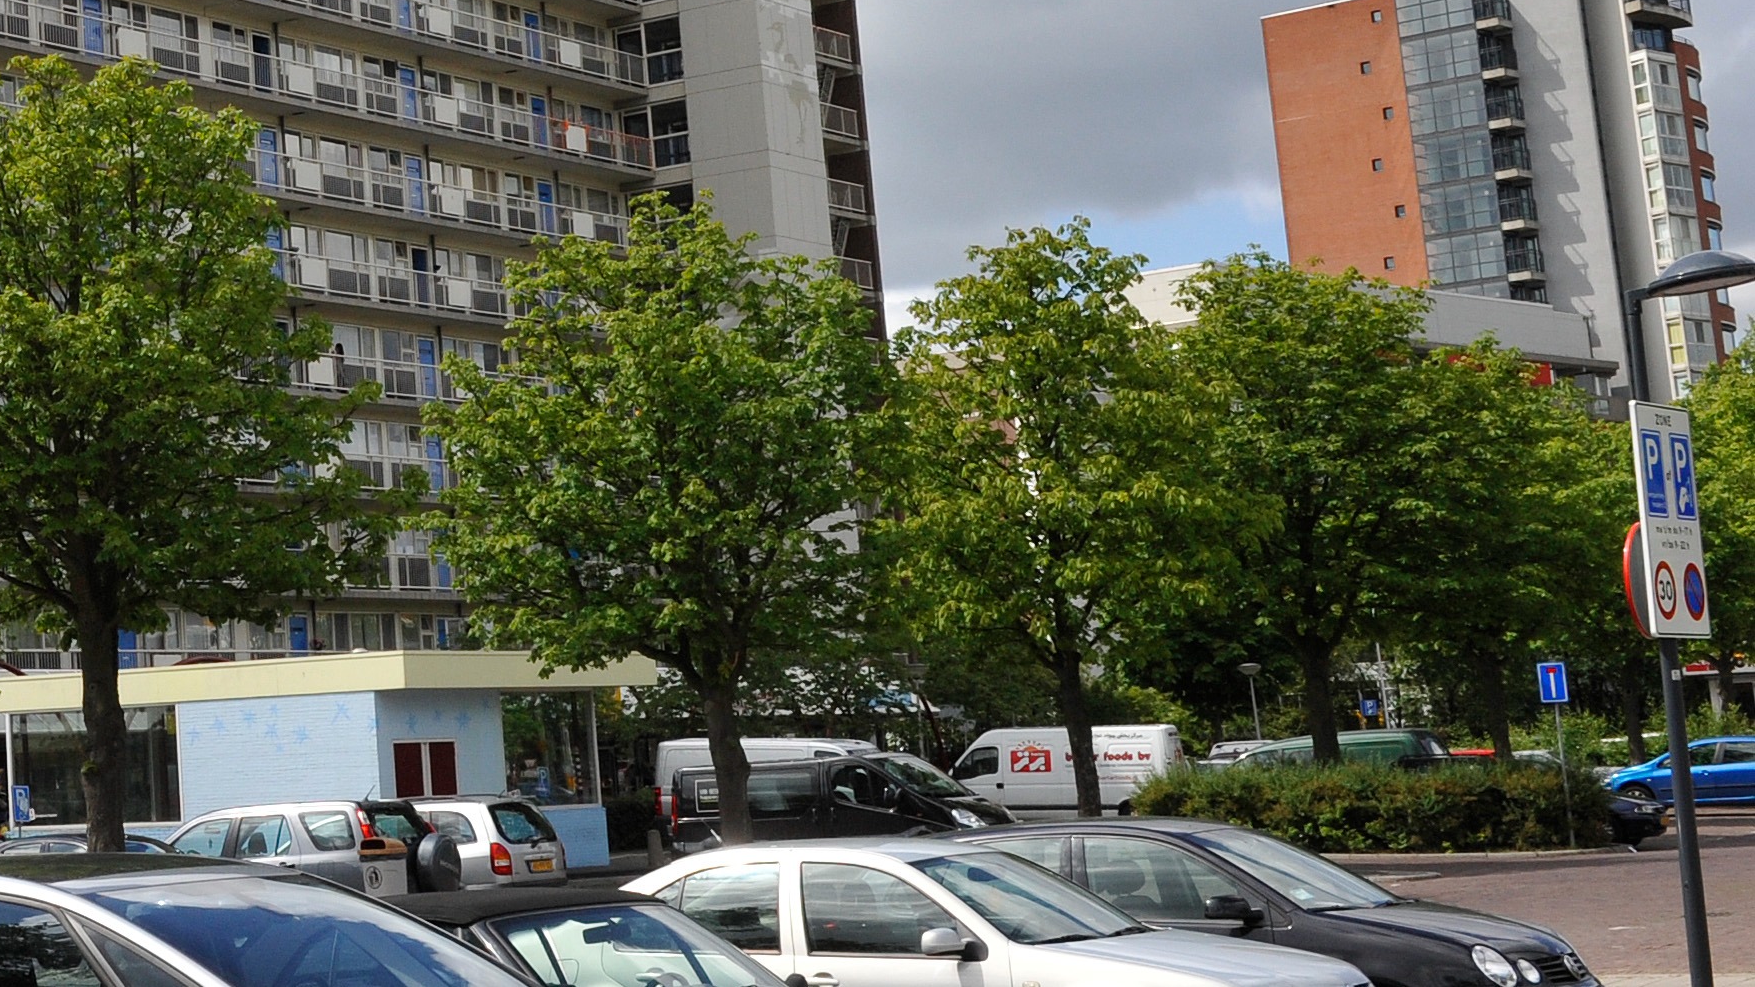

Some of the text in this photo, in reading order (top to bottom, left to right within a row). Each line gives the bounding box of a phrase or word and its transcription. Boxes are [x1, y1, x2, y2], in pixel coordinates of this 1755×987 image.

[1645, 438, 1658, 480] P
[1674, 442, 1687, 483] P
[1659, 580, 1673, 600] 30
[1104, 751, 1133, 761] foods
[1138, 751, 1152, 761] bv
